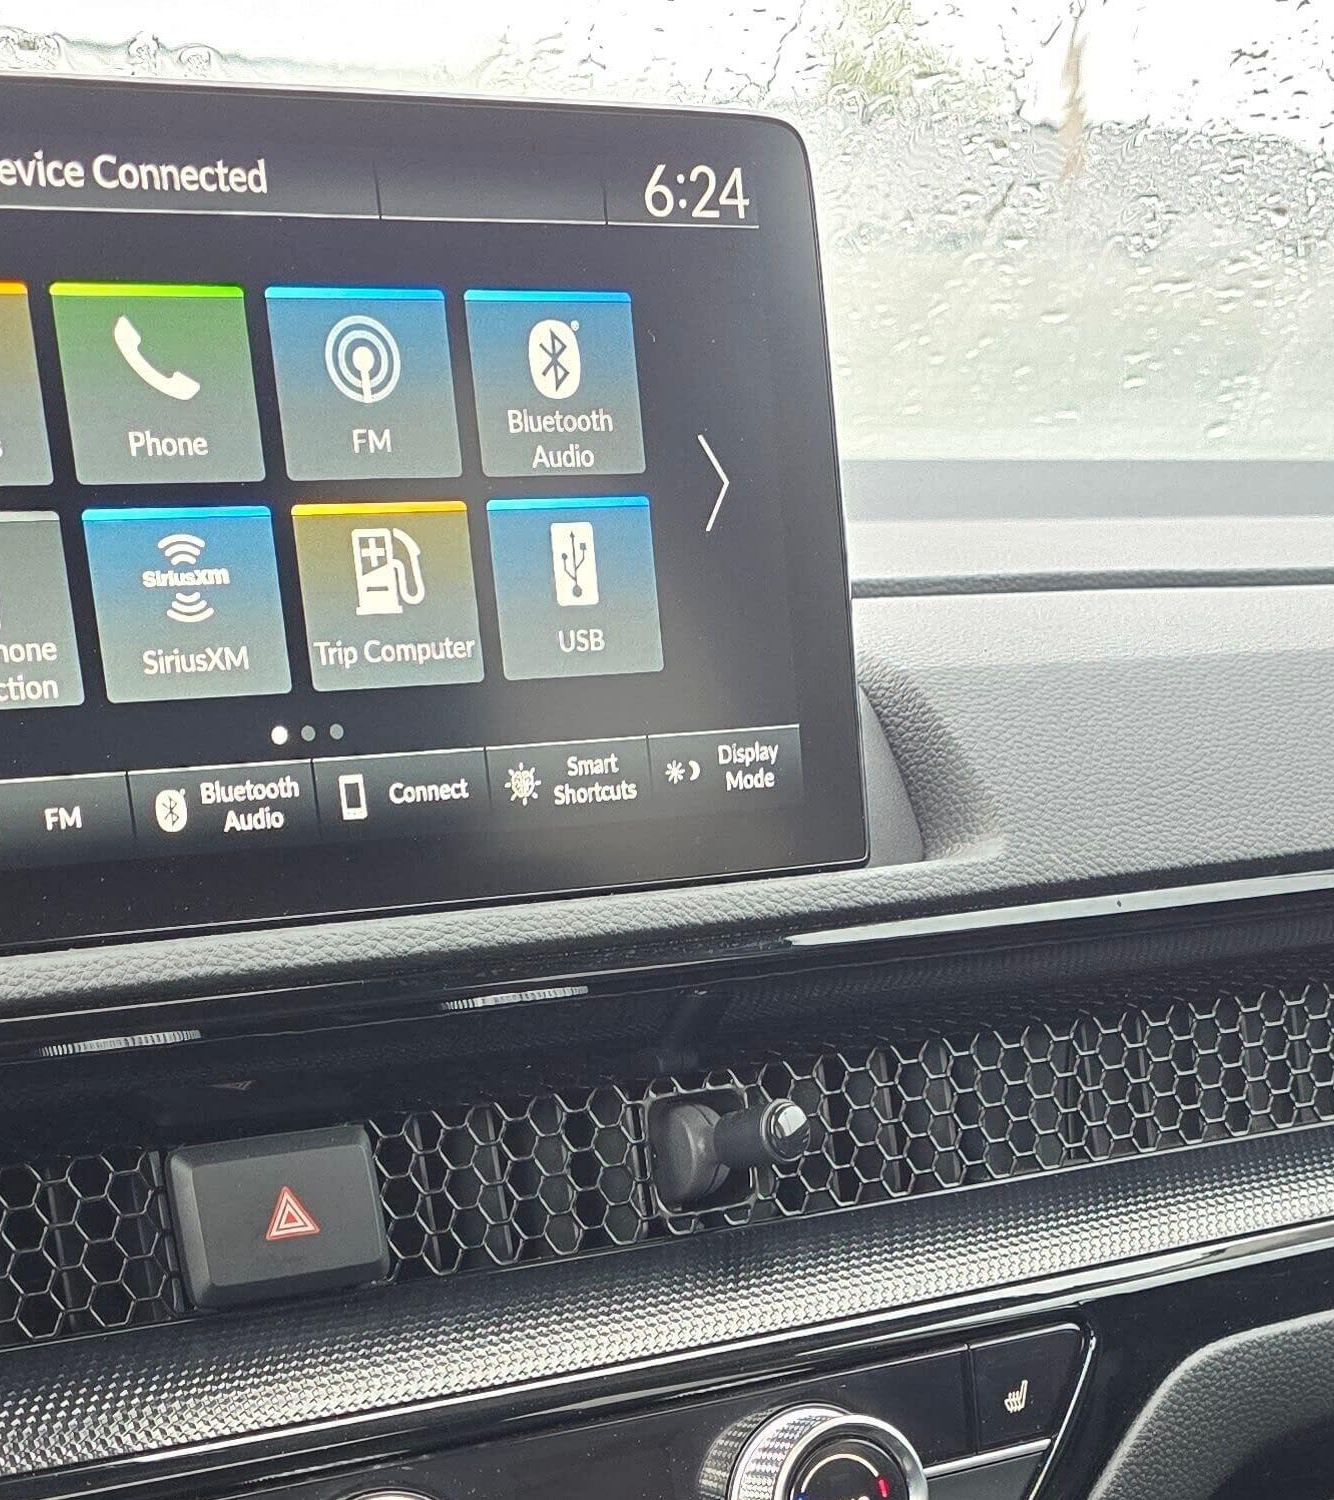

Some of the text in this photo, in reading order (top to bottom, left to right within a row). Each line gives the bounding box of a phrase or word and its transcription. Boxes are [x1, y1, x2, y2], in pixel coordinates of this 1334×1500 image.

[92, 154, 269, 194] Connected
[643, 163, 750, 222] 6:24
[507, 407, 615, 436] Bluetooth
[127, 430, 209, 458] Phone
[351, 428, 393, 454] FM
[530, 442, 596, 470] Audio
[313, 635, 476, 667] Trip Computer
[557, 628, 606, 654] USB
[142, 645, 251, 675] SiriusXM
[566, 752, 619, 778] Smart
[717, 740, 780, 770] Display
[199, 774, 301, 805] Bluetooth
[388, 777, 470, 804] Connect
[552, 778, 638, 808] Shortcuts
[725, 766, 776, 793] Mode
[44, 807, 82, 831] FM
[223, 806, 285, 833] Audio
